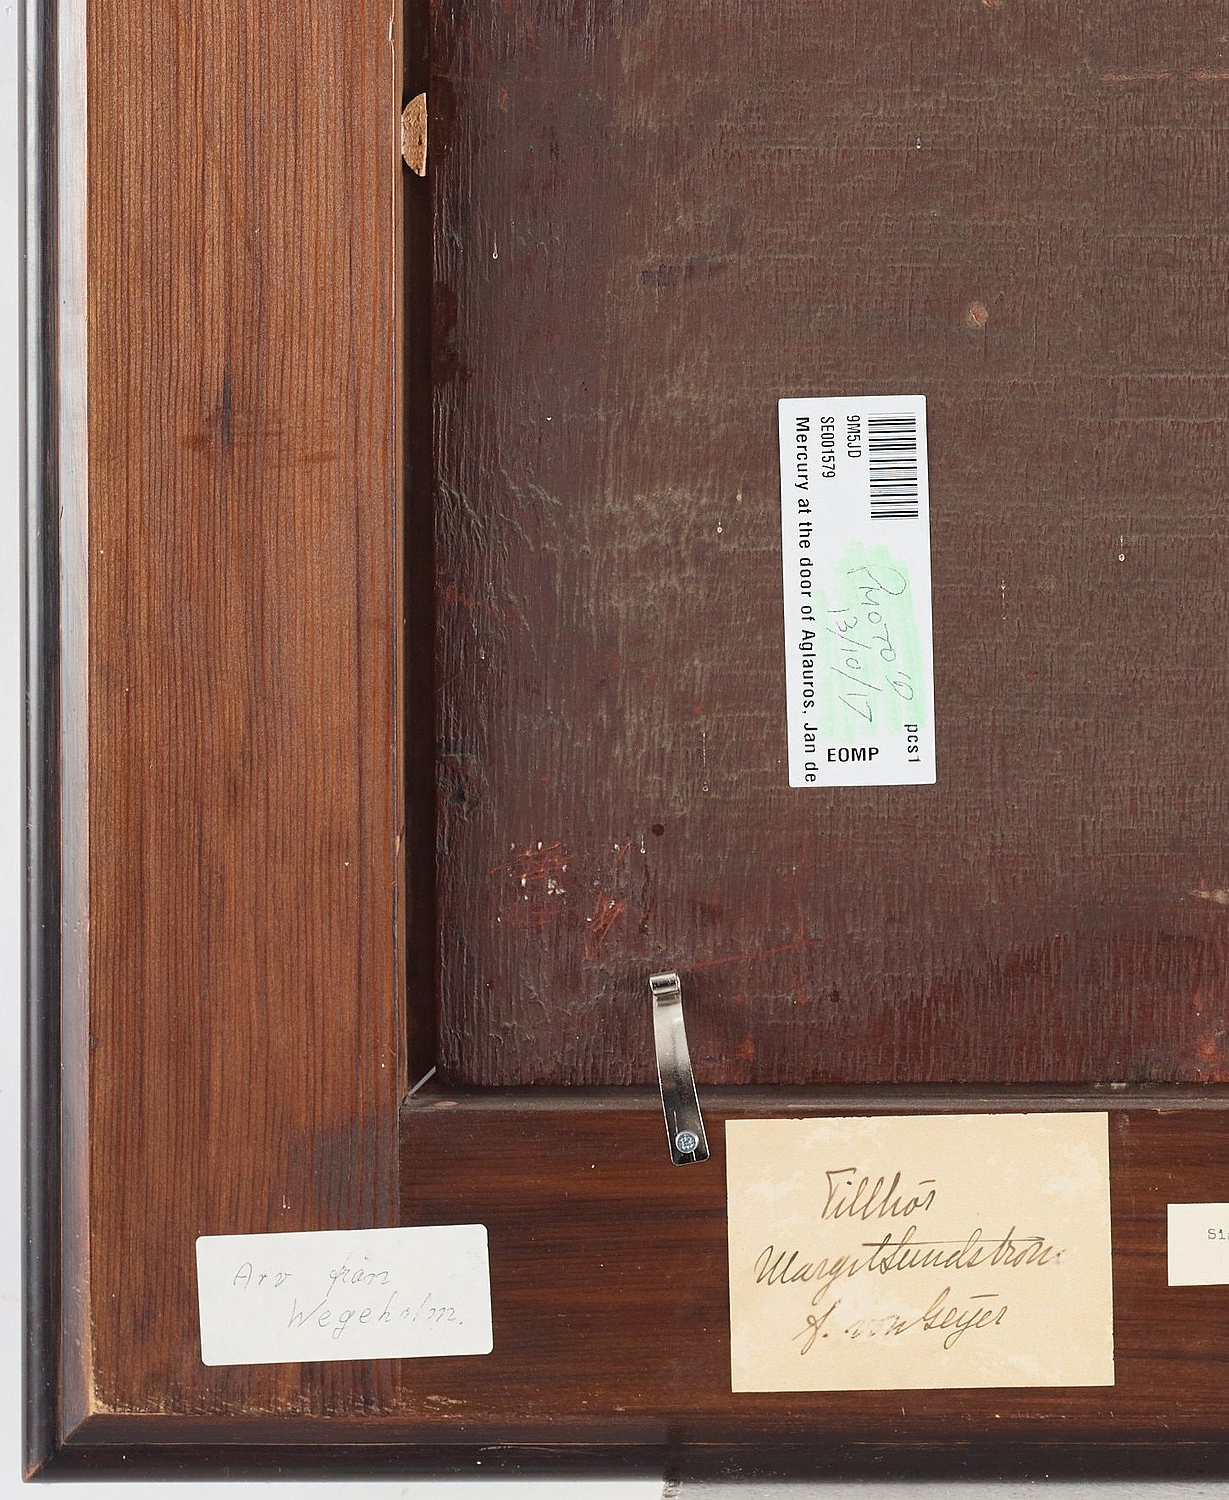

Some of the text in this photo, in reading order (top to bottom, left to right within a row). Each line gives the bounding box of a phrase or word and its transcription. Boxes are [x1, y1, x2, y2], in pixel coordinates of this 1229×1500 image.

[820, 416, 836, 478] SE001579
[846, 415, 862, 458] 9M5JD
[795, 416, 810, 490] Mercury
[797, 498, 810, 515] at
[798, 520, 811, 549] the
[798, 556, 812, 598] door
[800, 605, 814, 623] of
[803, 723, 816, 754] Jan
[827, 747, 879, 762] EOMP
[804, 760, 817, 783] de
